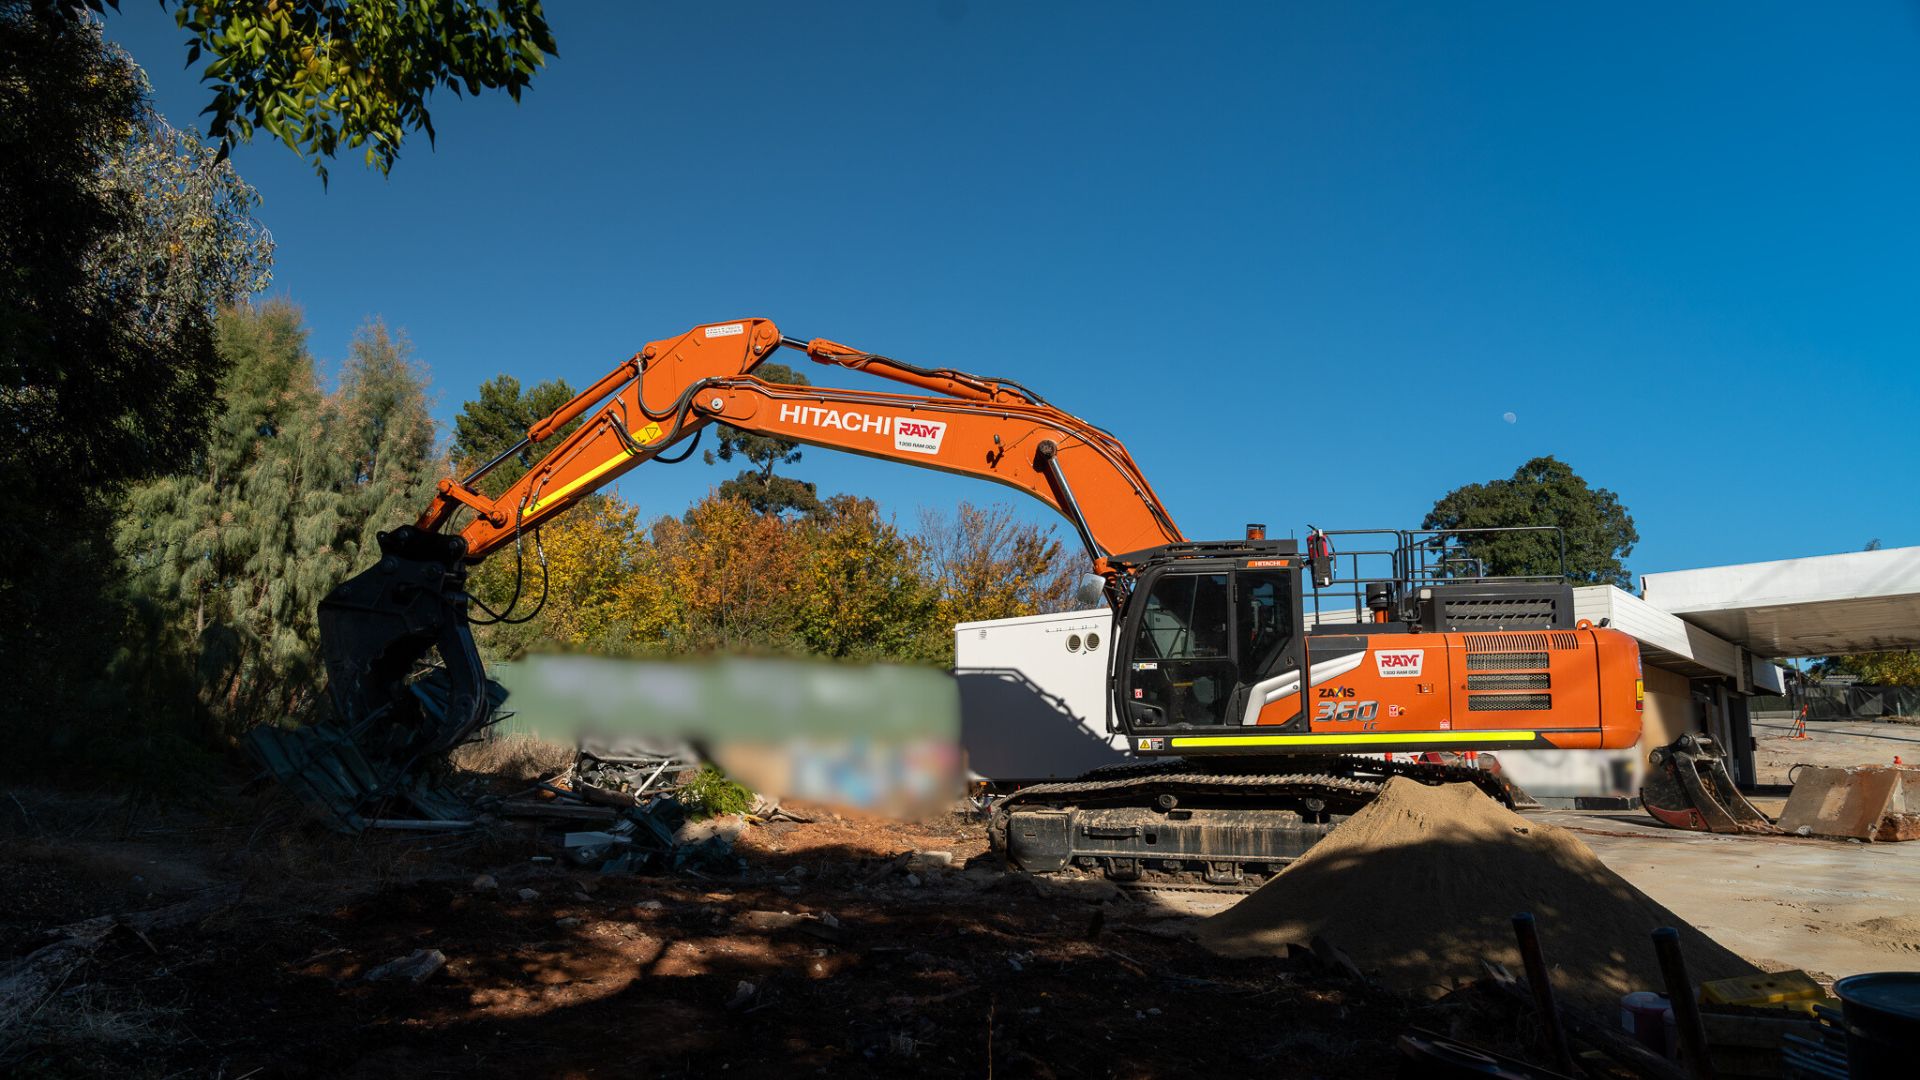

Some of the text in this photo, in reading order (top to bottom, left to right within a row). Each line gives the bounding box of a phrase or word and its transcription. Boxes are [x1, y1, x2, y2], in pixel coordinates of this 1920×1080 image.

[779, 403, 891, 435] HITACHI
[899, 422, 940, 439] RAM
[1381, 654, 1419, 667] RAM
[1318, 686, 1355, 698] ZAXIS
[1313, 701, 1379, 721] 360
